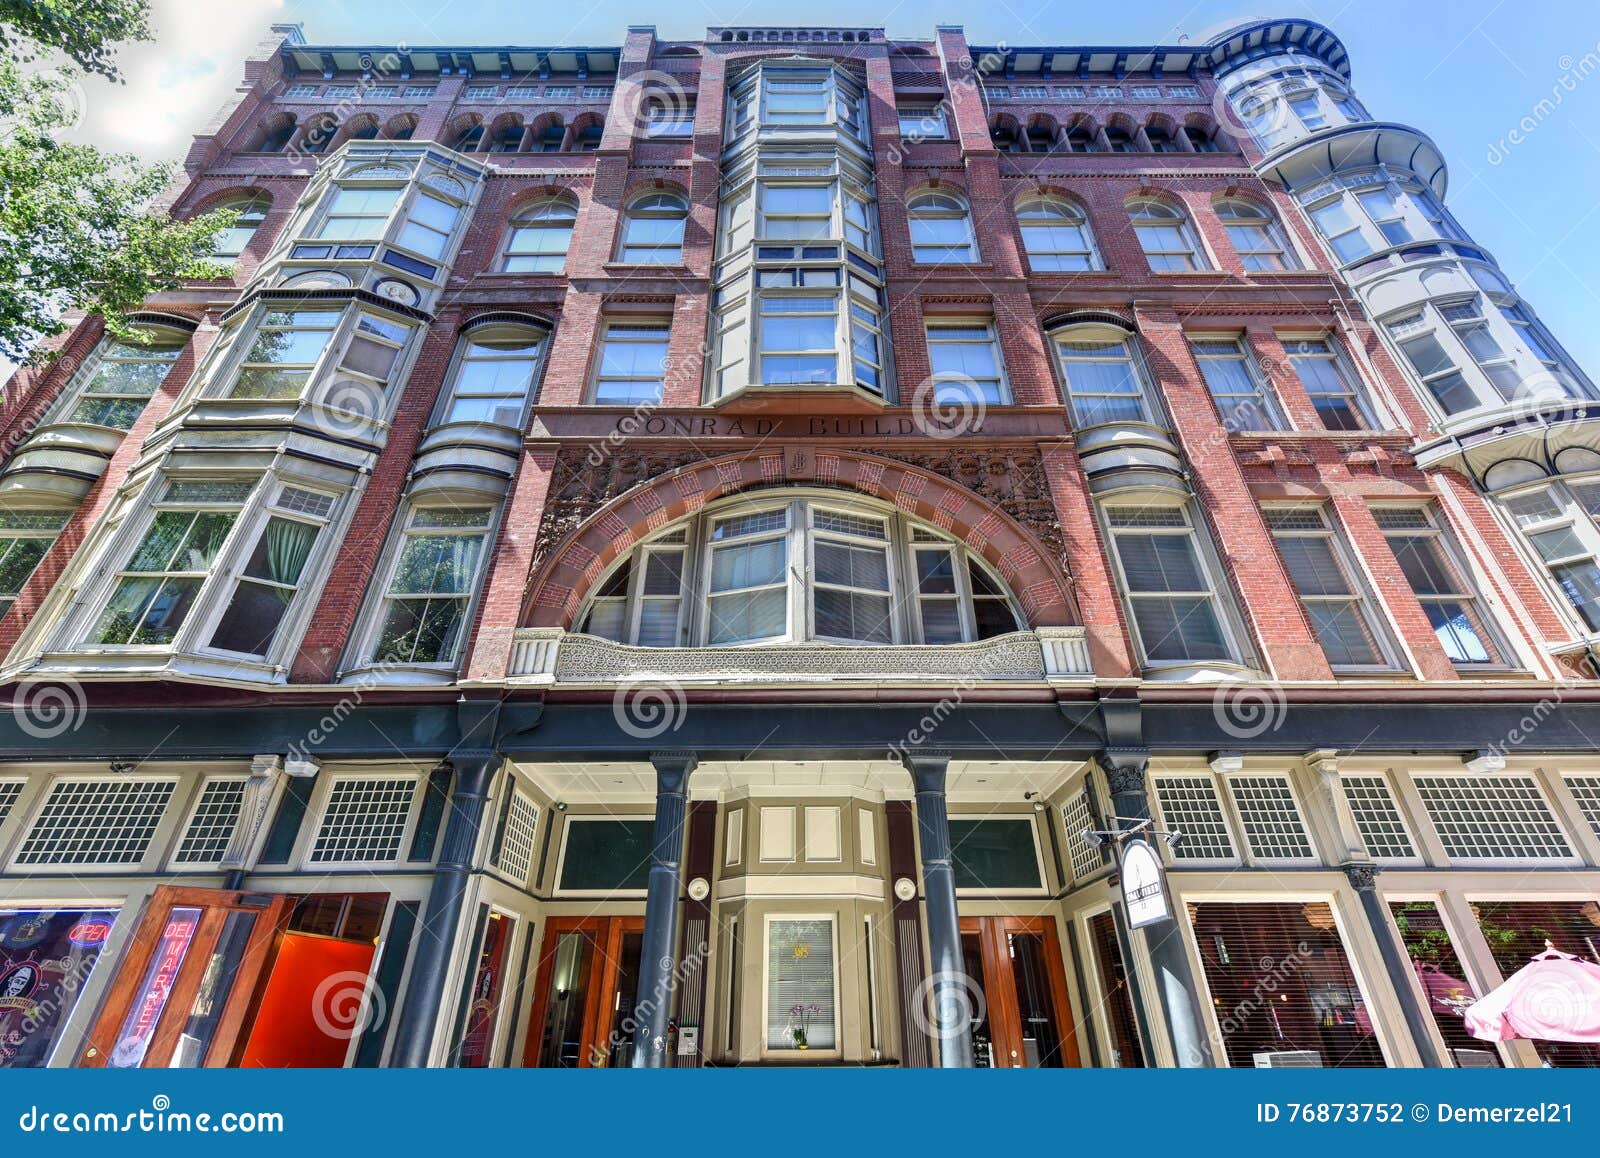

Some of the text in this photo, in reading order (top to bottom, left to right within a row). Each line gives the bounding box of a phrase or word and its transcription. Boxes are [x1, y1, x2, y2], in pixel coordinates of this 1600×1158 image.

[616, 417, 984, 436] CONRAD BUILDING
[69, 924, 110, 942] OPEN
